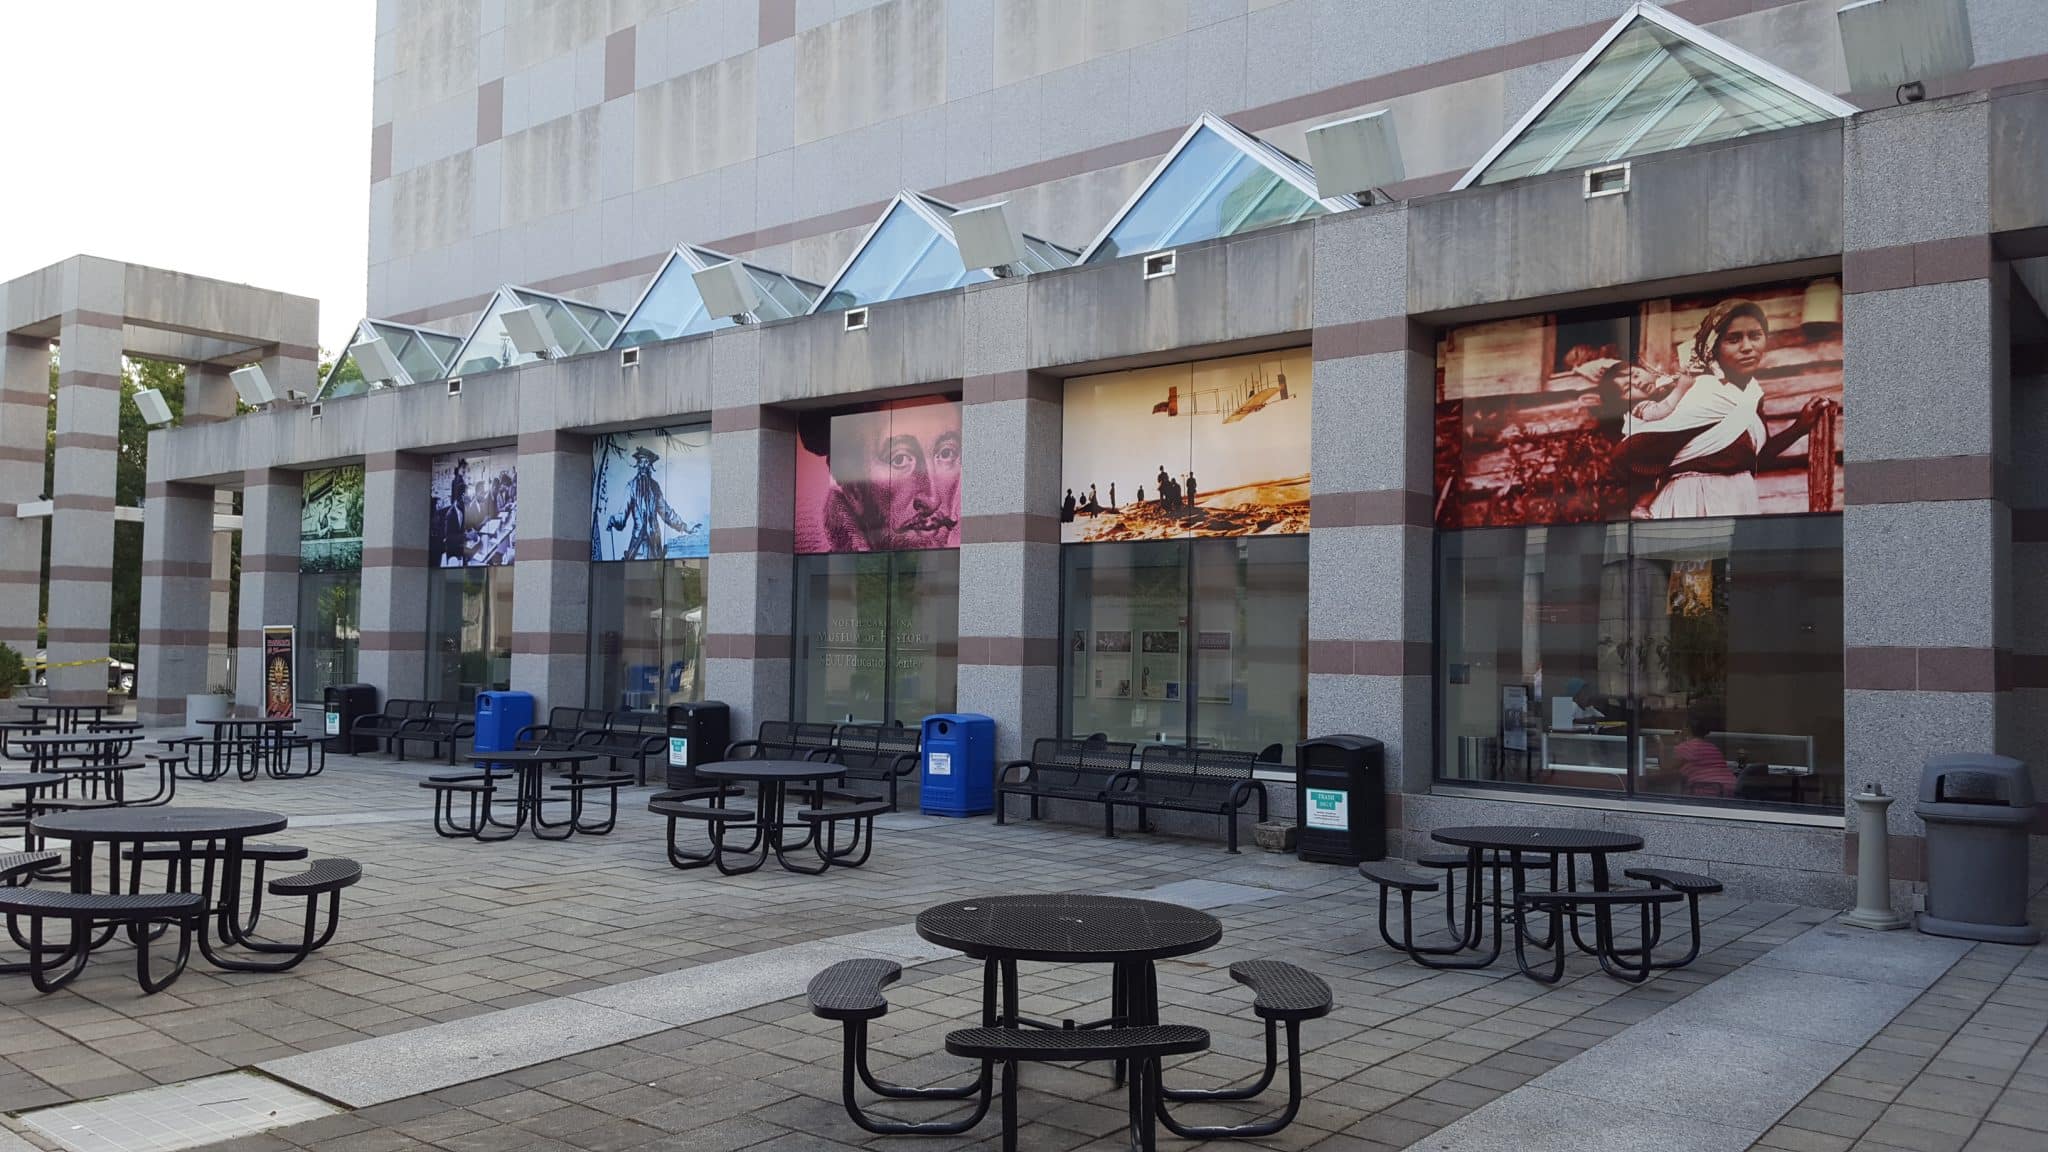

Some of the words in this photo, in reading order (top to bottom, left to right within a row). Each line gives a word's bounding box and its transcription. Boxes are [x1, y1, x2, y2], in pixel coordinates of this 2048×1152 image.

[867, 618, 912, 629] CARINA
[880, 630, 928, 643] HSTOR
[846, 654, 885, 667] Educatio
